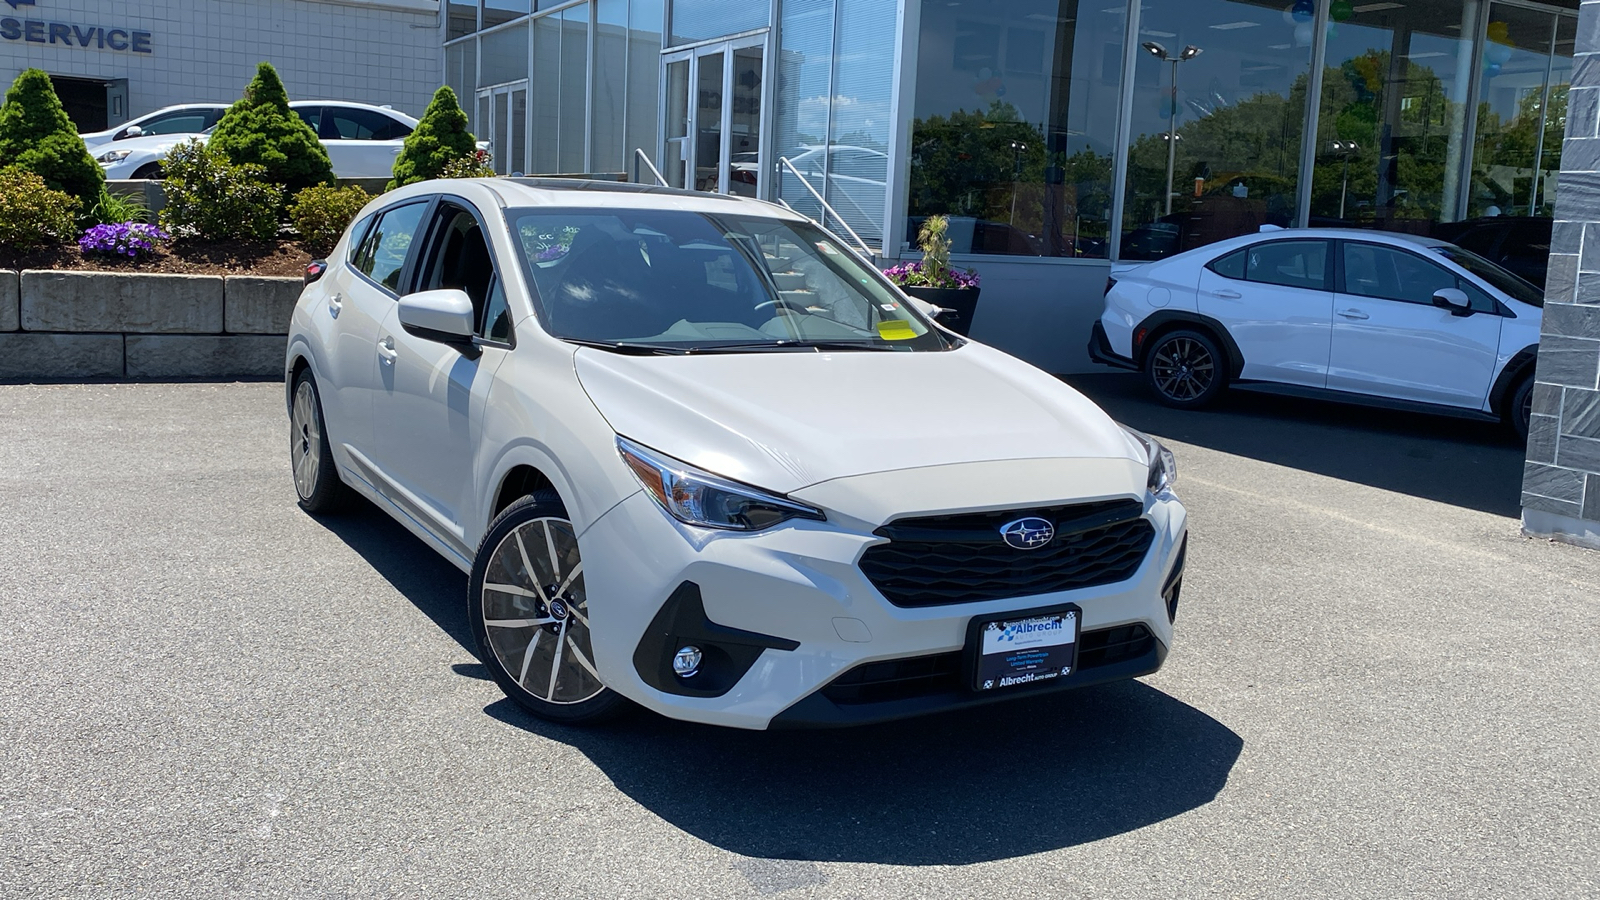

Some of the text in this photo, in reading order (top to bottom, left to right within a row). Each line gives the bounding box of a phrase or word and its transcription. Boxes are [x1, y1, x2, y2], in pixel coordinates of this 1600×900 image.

[0, 18, 152, 53] SERVICE
[1016, 620, 1062, 634] Albrecht
[1015, 630, 1062, 640] AUTO GROUP
[999, 673, 1034, 687] Albrecht
